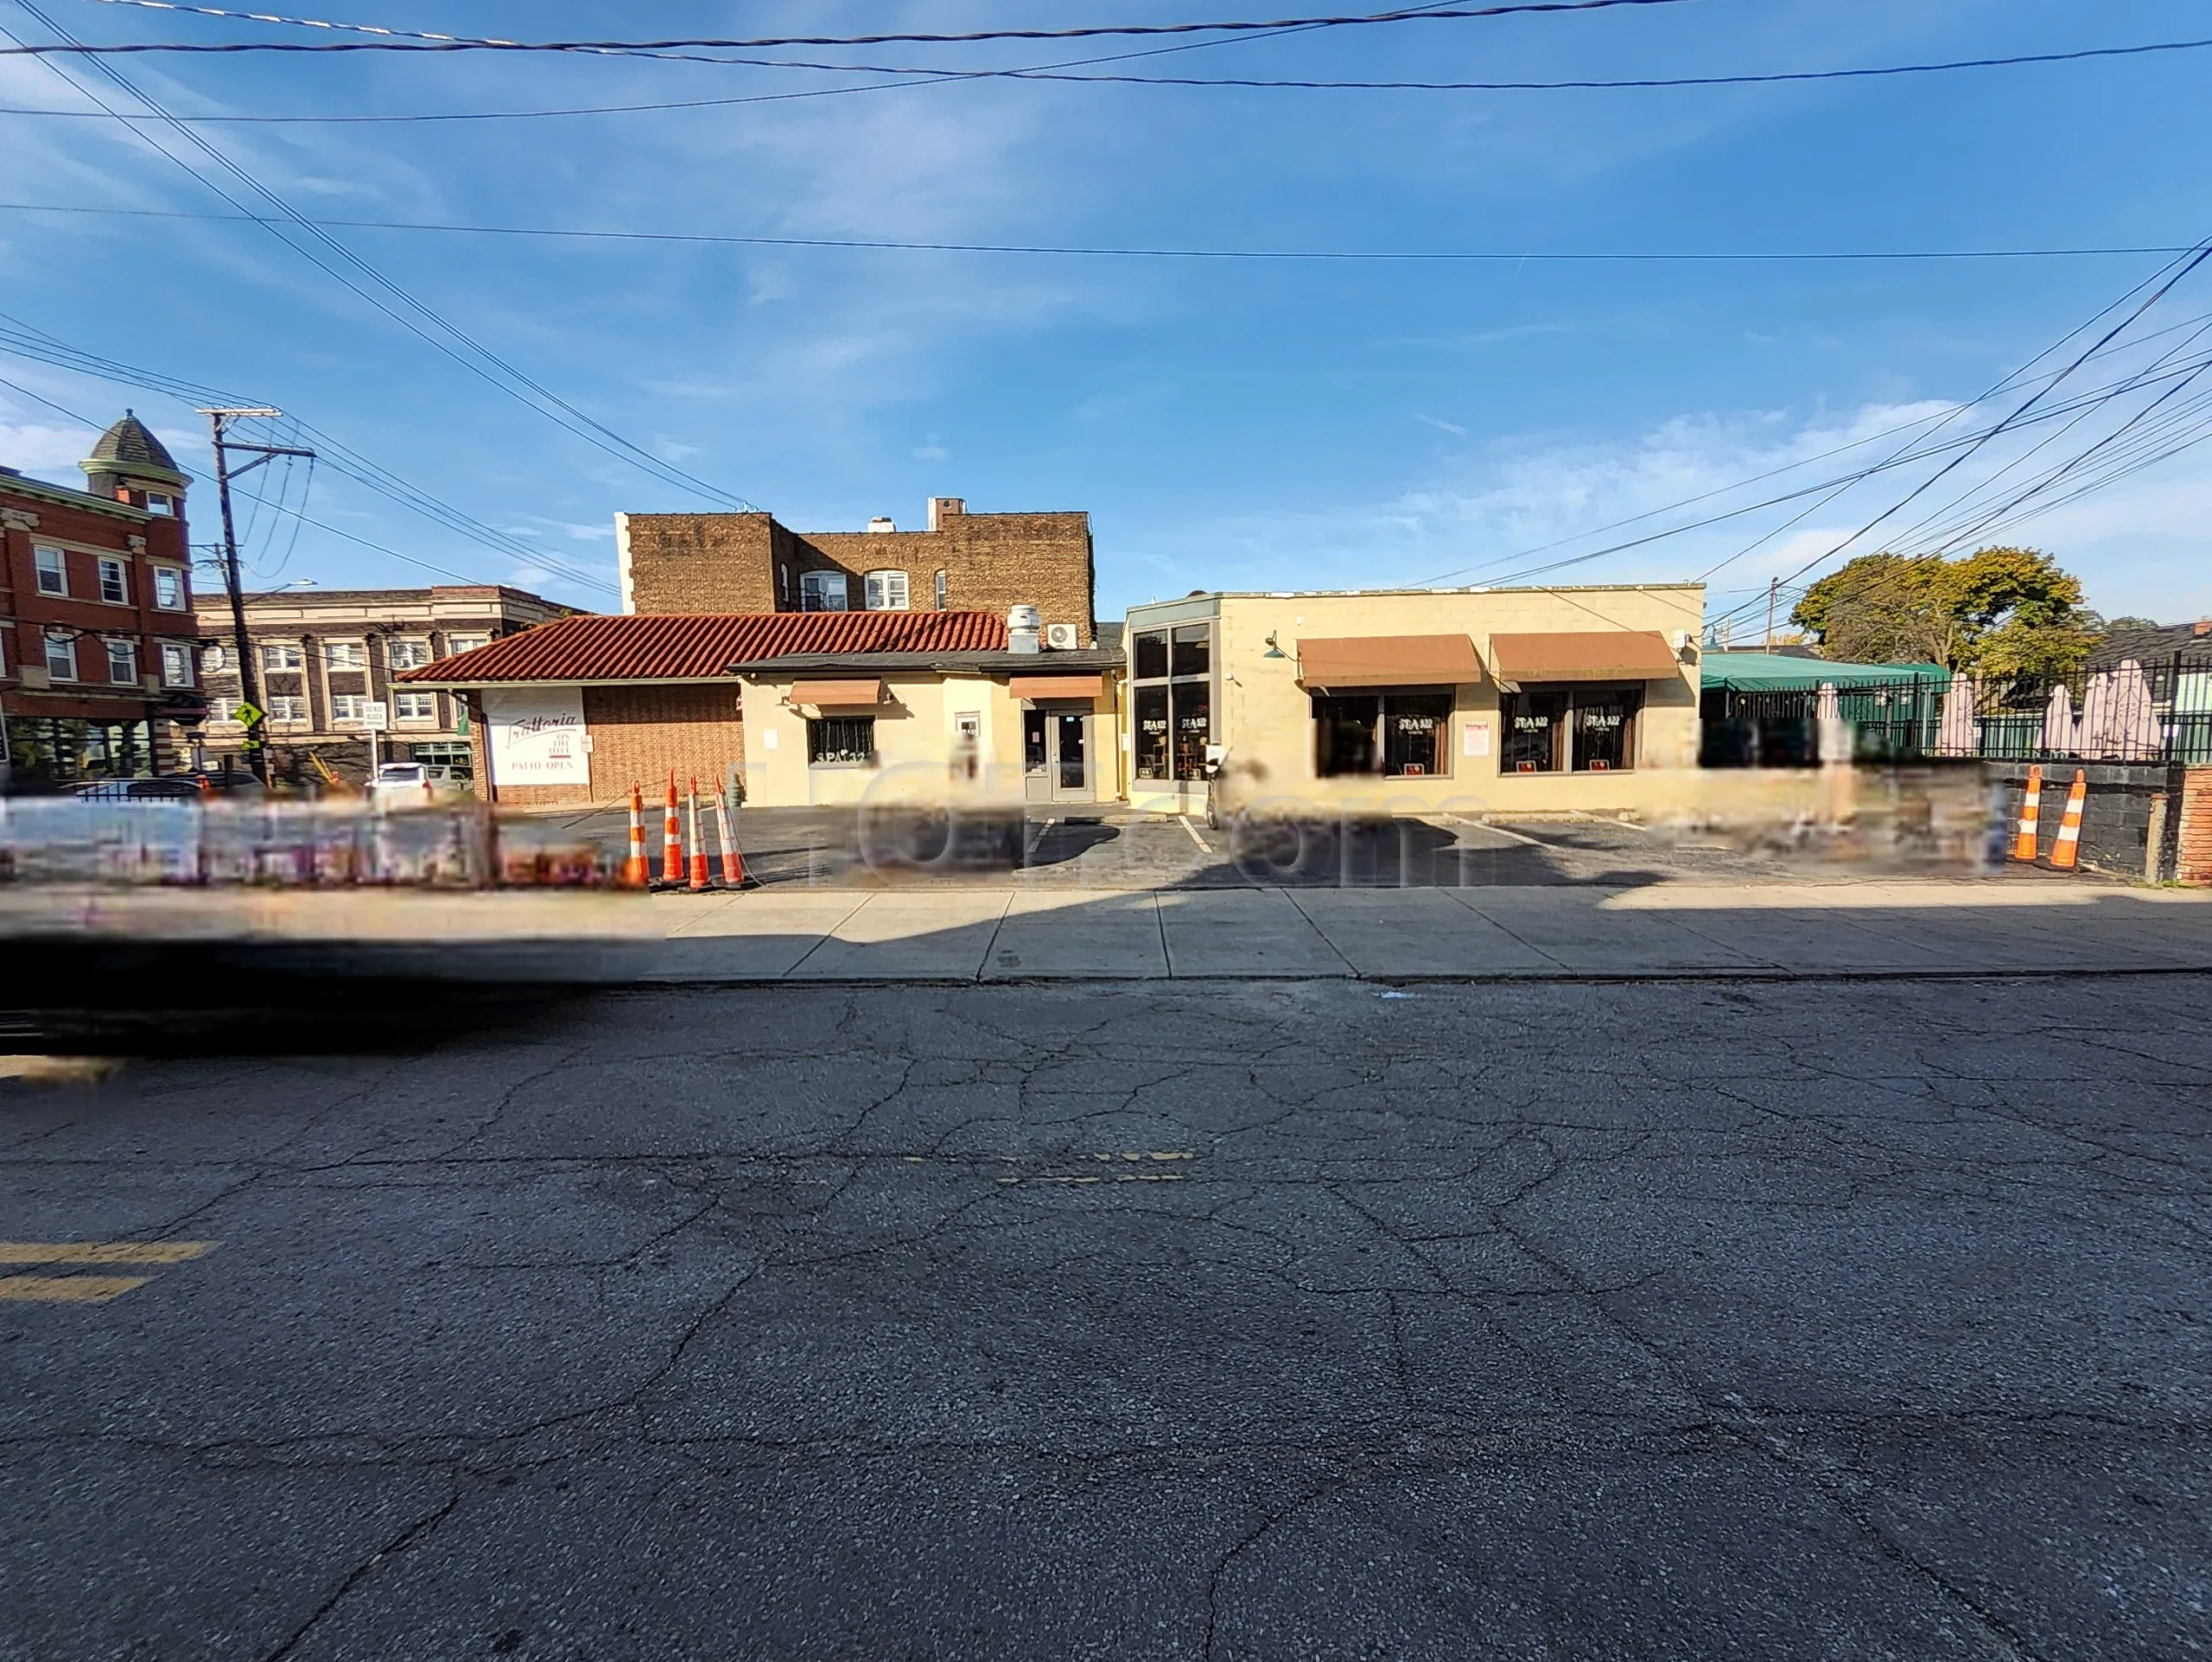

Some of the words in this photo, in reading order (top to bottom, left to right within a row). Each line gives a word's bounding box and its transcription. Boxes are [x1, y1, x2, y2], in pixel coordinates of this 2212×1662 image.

[505, 712, 576, 749] Trattoria
[512, 761, 542, 770] PATIO
[546, 761, 574, 770] OPEN
